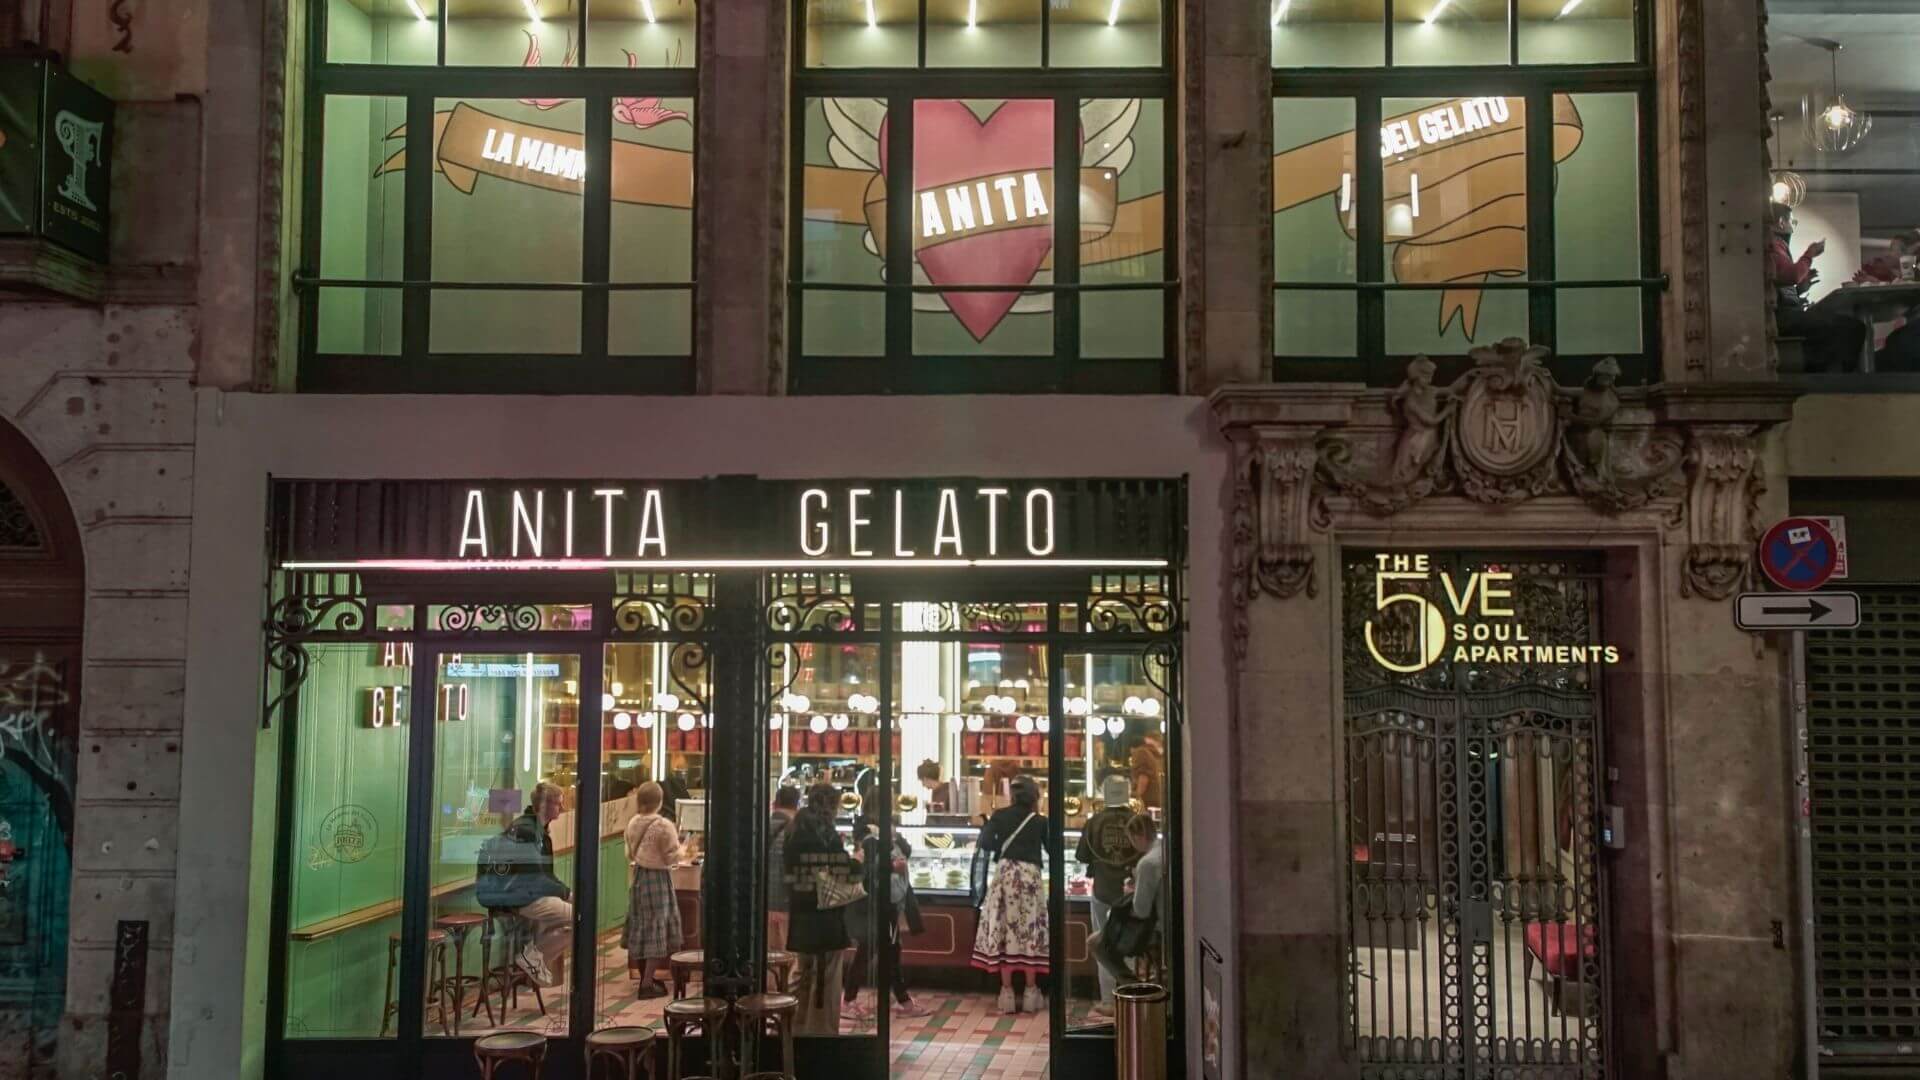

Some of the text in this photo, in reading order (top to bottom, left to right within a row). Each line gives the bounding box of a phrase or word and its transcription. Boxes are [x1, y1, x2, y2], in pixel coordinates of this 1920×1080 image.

[1418, 97, 1509, 144] GELATO
[482, 128, 515, 164] LA
[920, 172, 1049, 237] ANITA
[458, 488, 1056, 557] ANITA GELATO
[1375, 554, 1430, 572] THE
[1453, 623, 1530, 641] SOUL
[1453, 645, 1620, 664] APARTMENTS
